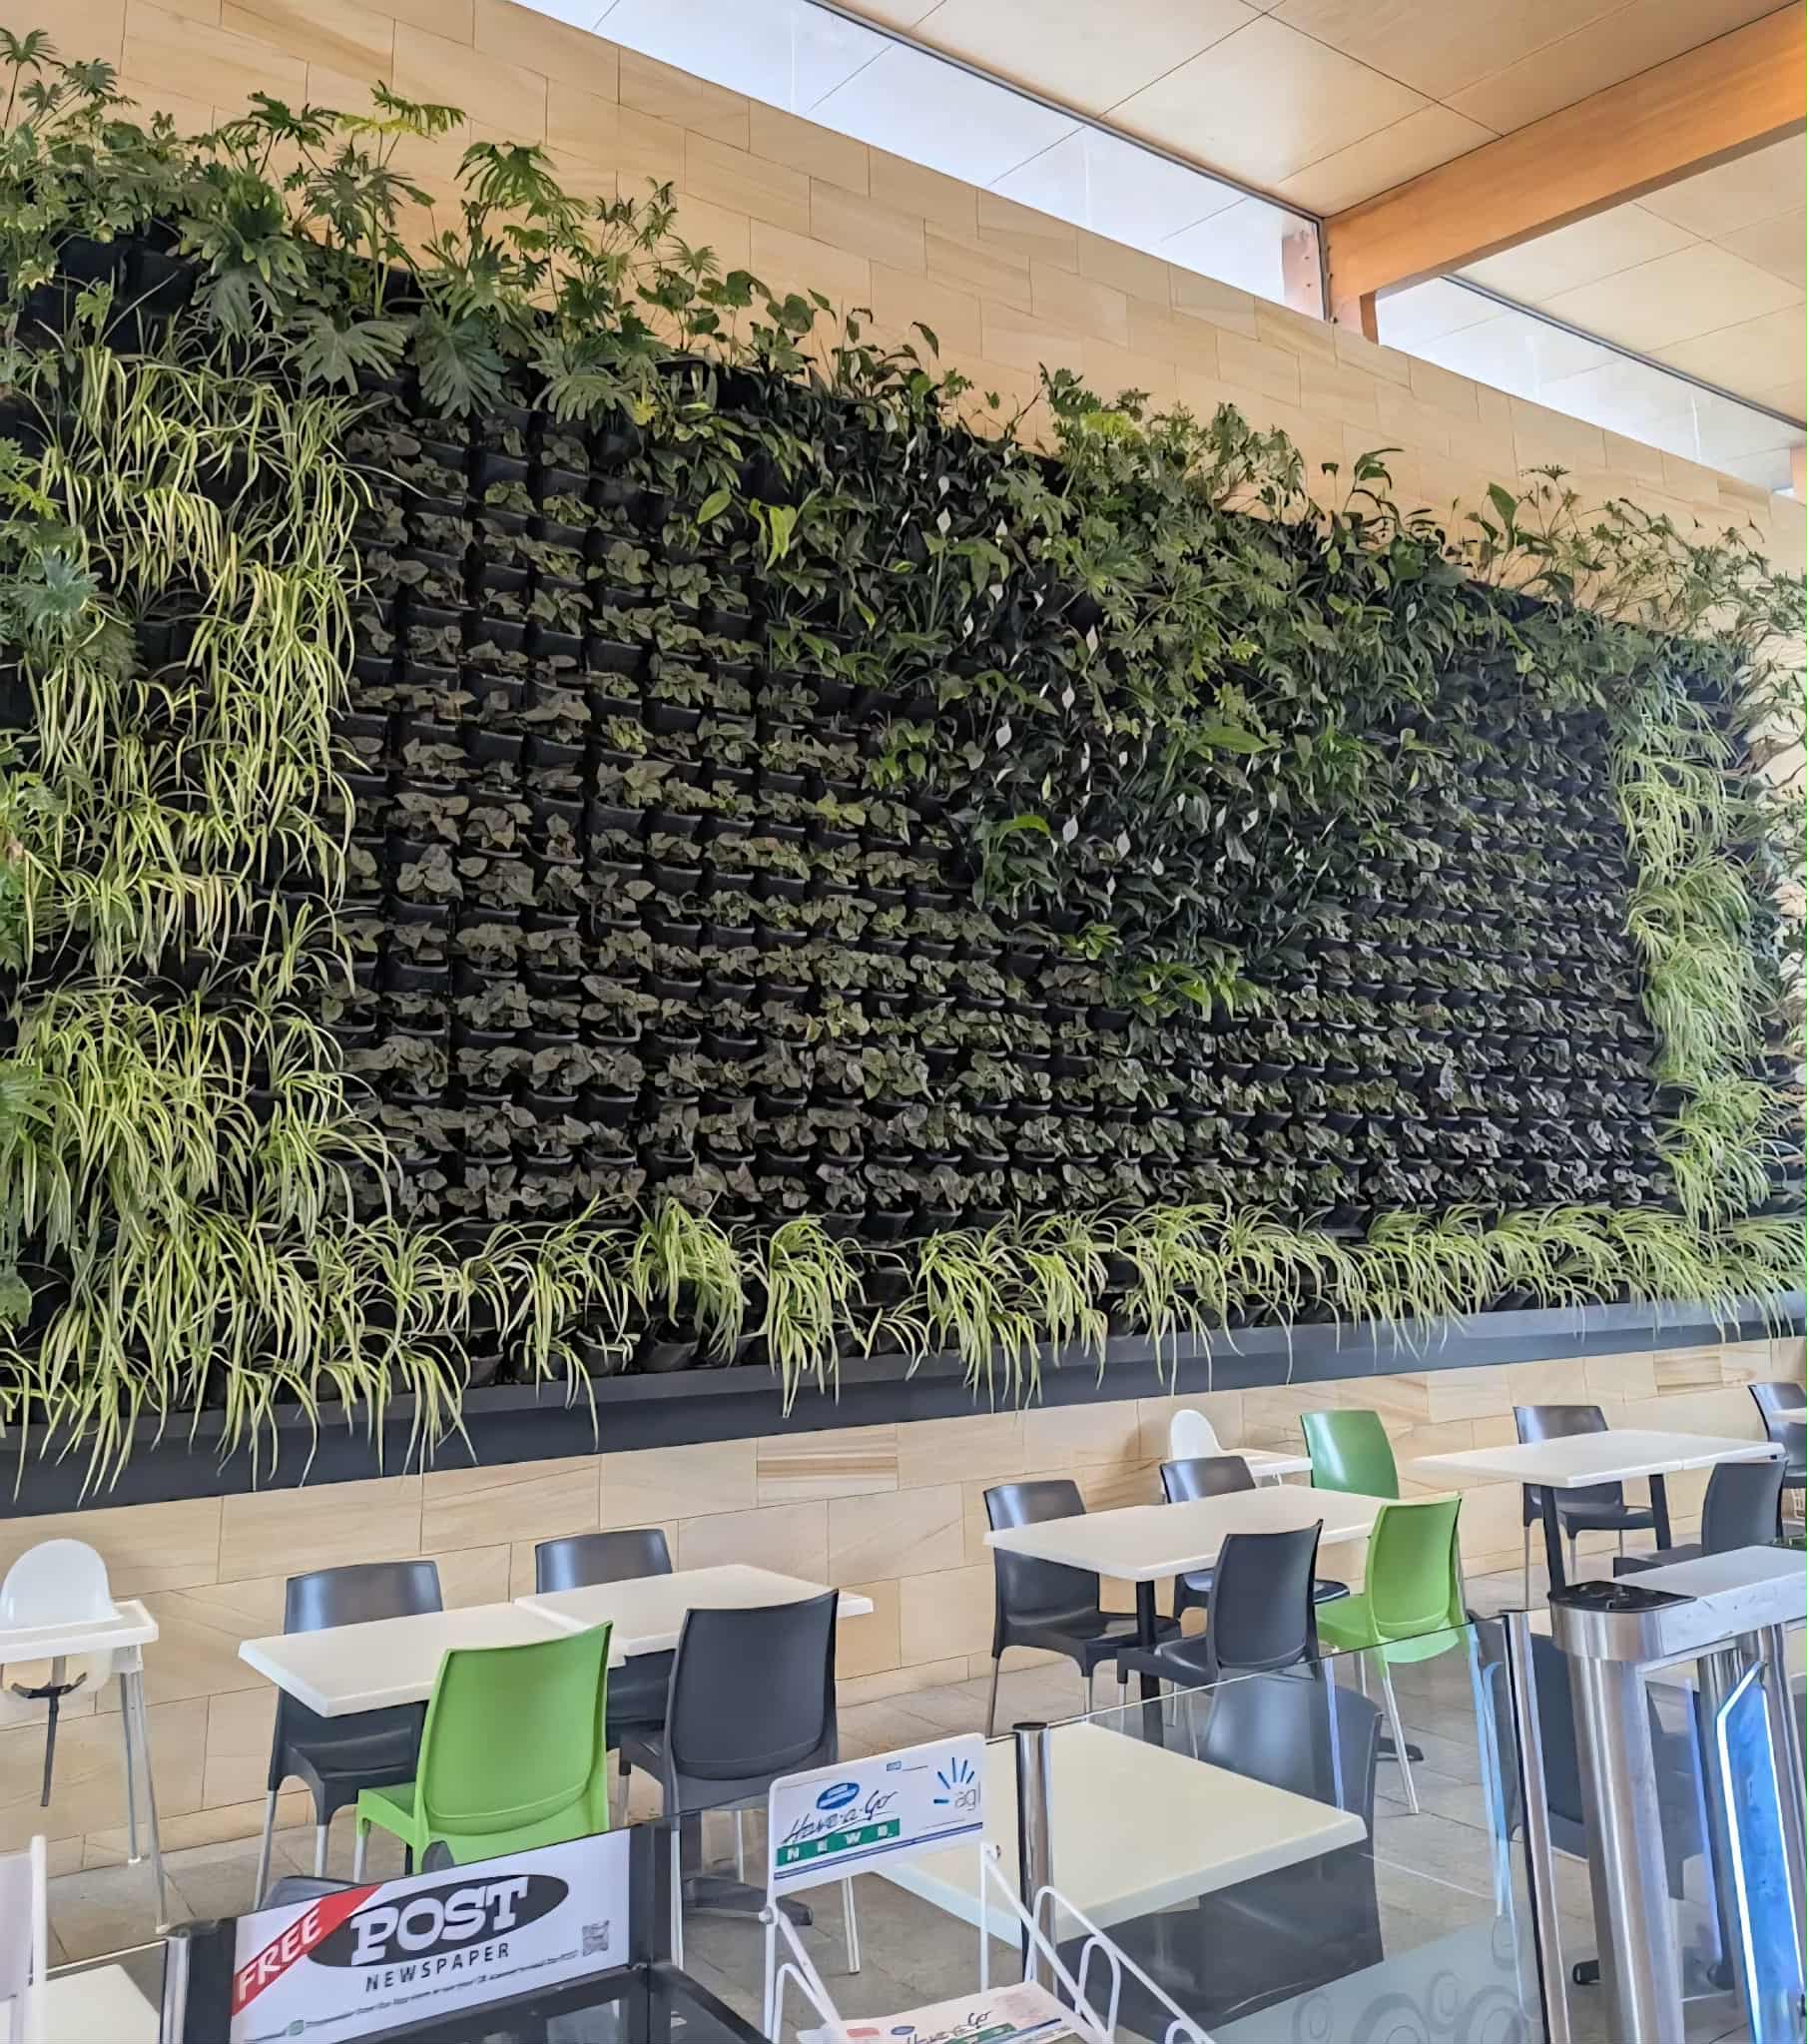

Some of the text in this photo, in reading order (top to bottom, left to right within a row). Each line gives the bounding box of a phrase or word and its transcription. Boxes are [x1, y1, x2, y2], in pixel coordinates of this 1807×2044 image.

[239, 1911, 321, 2001] FREE
[350, 1876, 528, 1966] POST
[364, 1942, 510, 1992] NEWSPAPER
